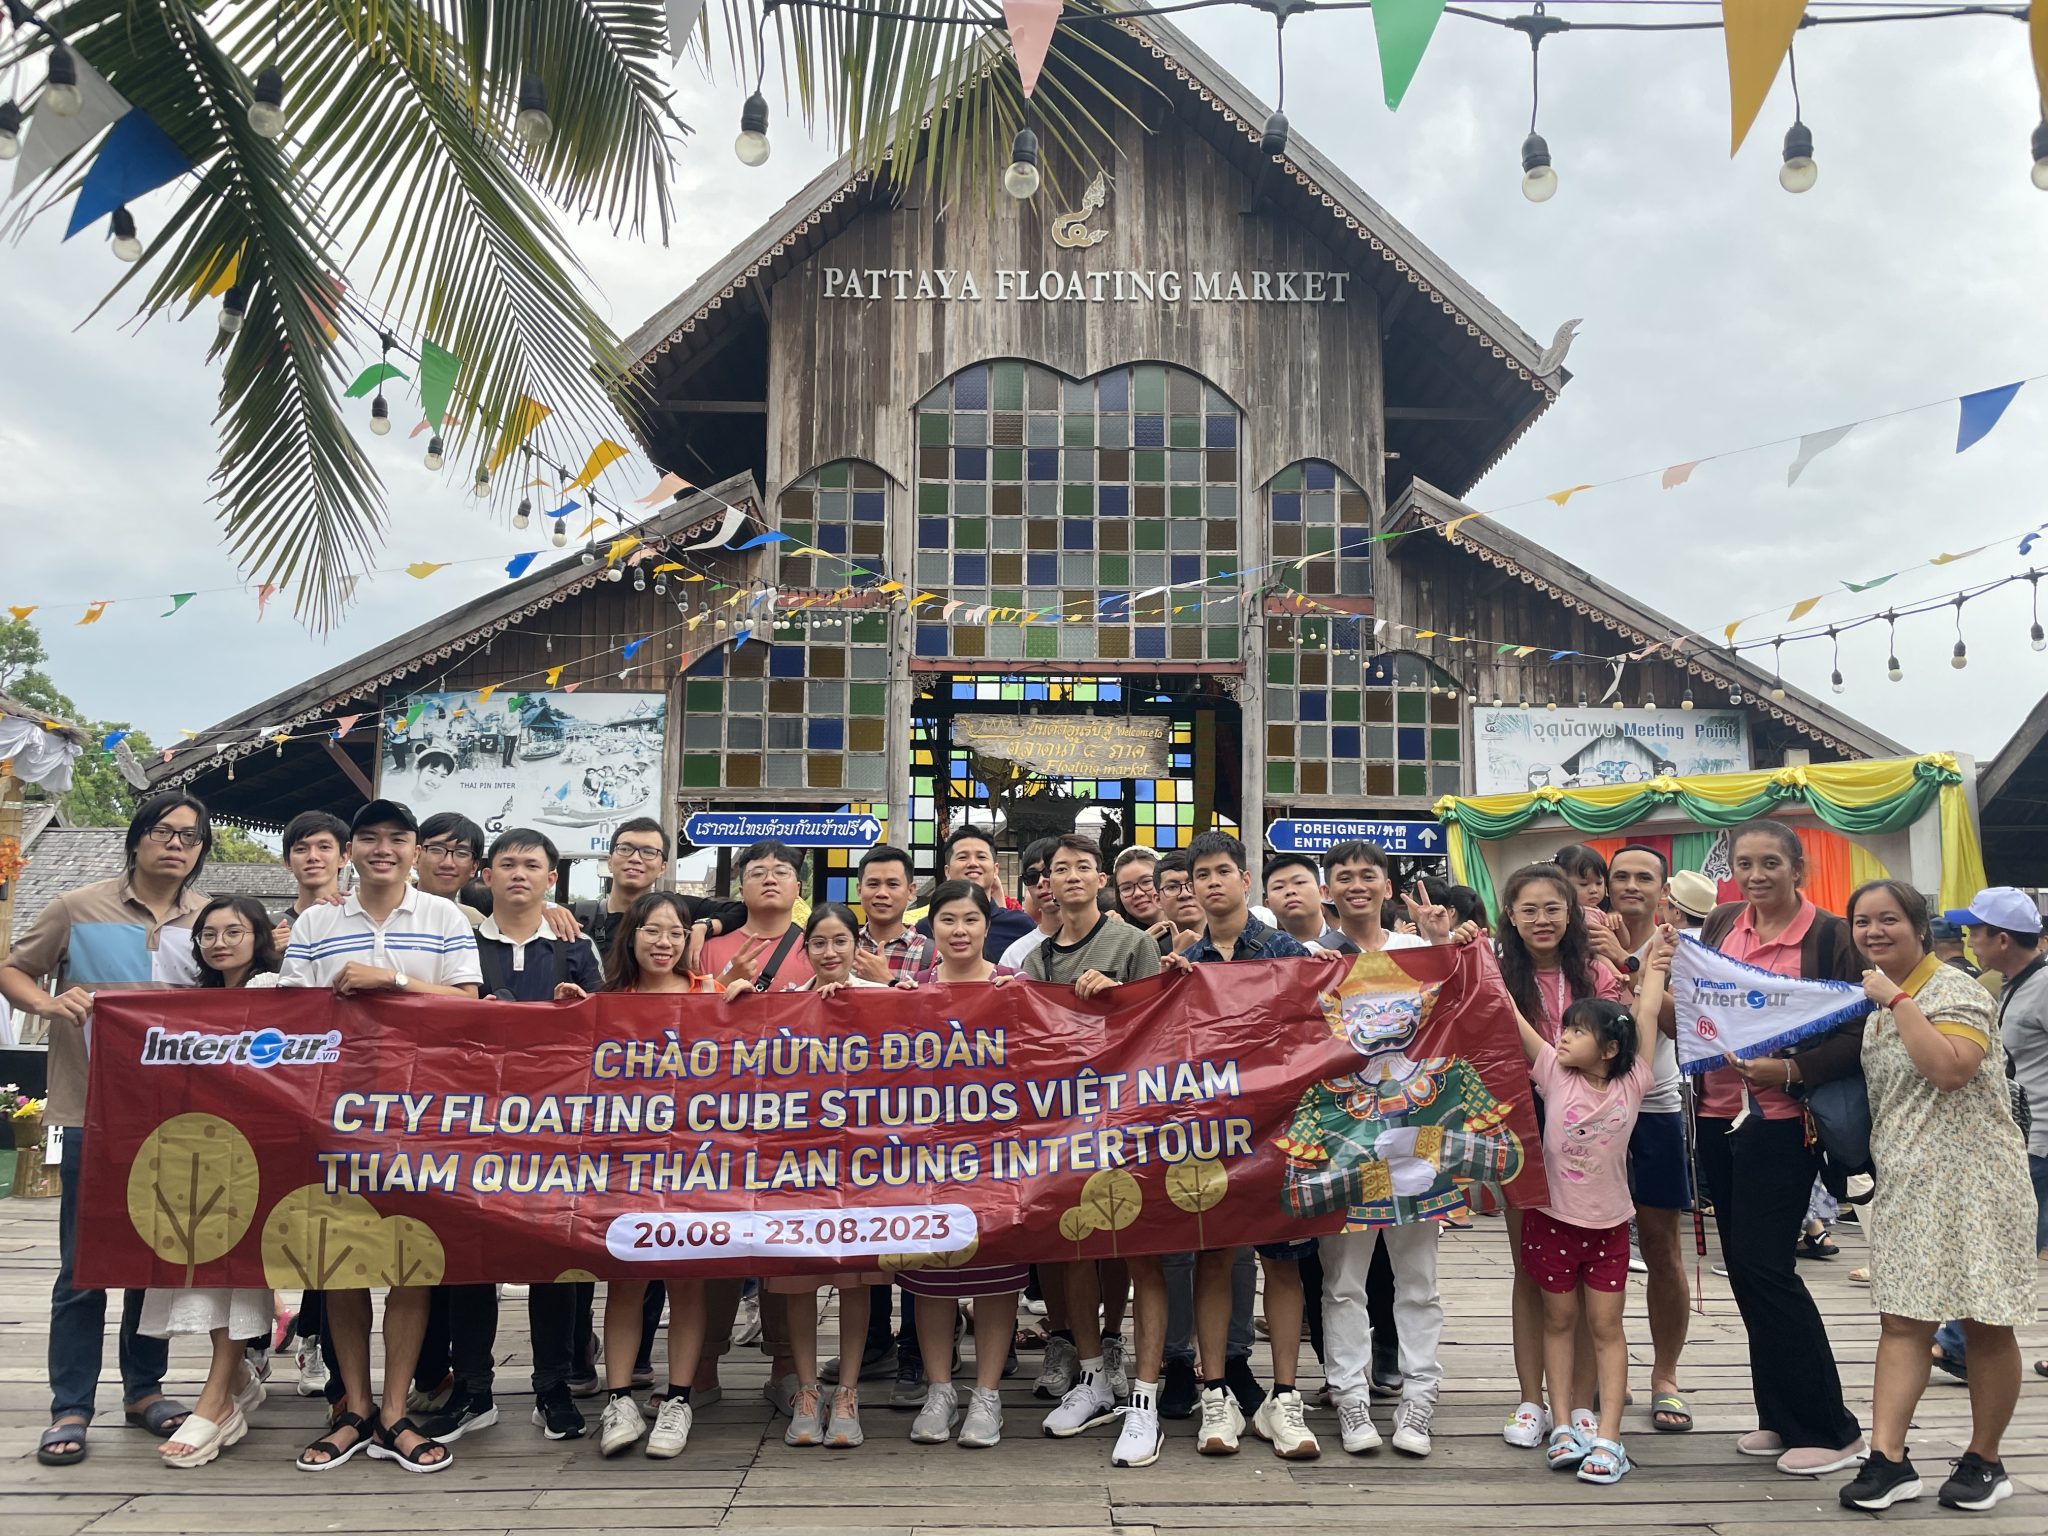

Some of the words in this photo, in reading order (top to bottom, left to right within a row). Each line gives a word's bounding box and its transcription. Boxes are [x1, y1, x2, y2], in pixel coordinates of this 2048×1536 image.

[824, 268, 981, 300] PATTAYA
[996, 270, 1181, 301] FLOATING
[1193, 271, 1350, 302] MARKET
[1116, 726, 1153, 737] Welcome
[1155, 727, 1163, 738] to
[1533, 718, 1615, 742] จุดนัดพบ
[1624, 722, 1684, 740] Meeting
[1695, 723, 1735, 739] Point
[1041, 759, 1100, 777] Floating
[1103, 762, 1150, 777] market
[696, 816, 860, 836] เราคนไทยด้วยกันเข้าฟรี
[1692, 977, 1737, 990] Vietnam
[1692, 988, 1790, 1009] Intertour
[1700, 1020, 1716, 1036] 68
[593, 1030, 719, 1079] CHÀO
[731, 1027, 870, 1076] MỪNG
[879, 1020, 1006, 1070] ĐOÀN
[332, 1093, 434, 1132] CTY
[439, 1094, 676, 1133] FLOATING
[687, 1091, 809, 1131] CUBE
[820, 1081, 1019, 1128] STUDIOS
[1028, 1066, 1127, 1122] VIỆT
[1137, 1060, 1241, 1103] NAM
[317, 1153, 460, 1193] THAM
[472, 1153, 608, 1193] QUAN
[621, 1140, 731, 1192] THÁI
[743, 1148, 838, 1190] LAN
[851, 1135, 979, 1185] CÙNG
[993, 1117, 1254, 1179] INTERTOUR
[632, 1220, 732, 1249] 20.08
[764, 1213, 951, 1246] 23.08.2023
